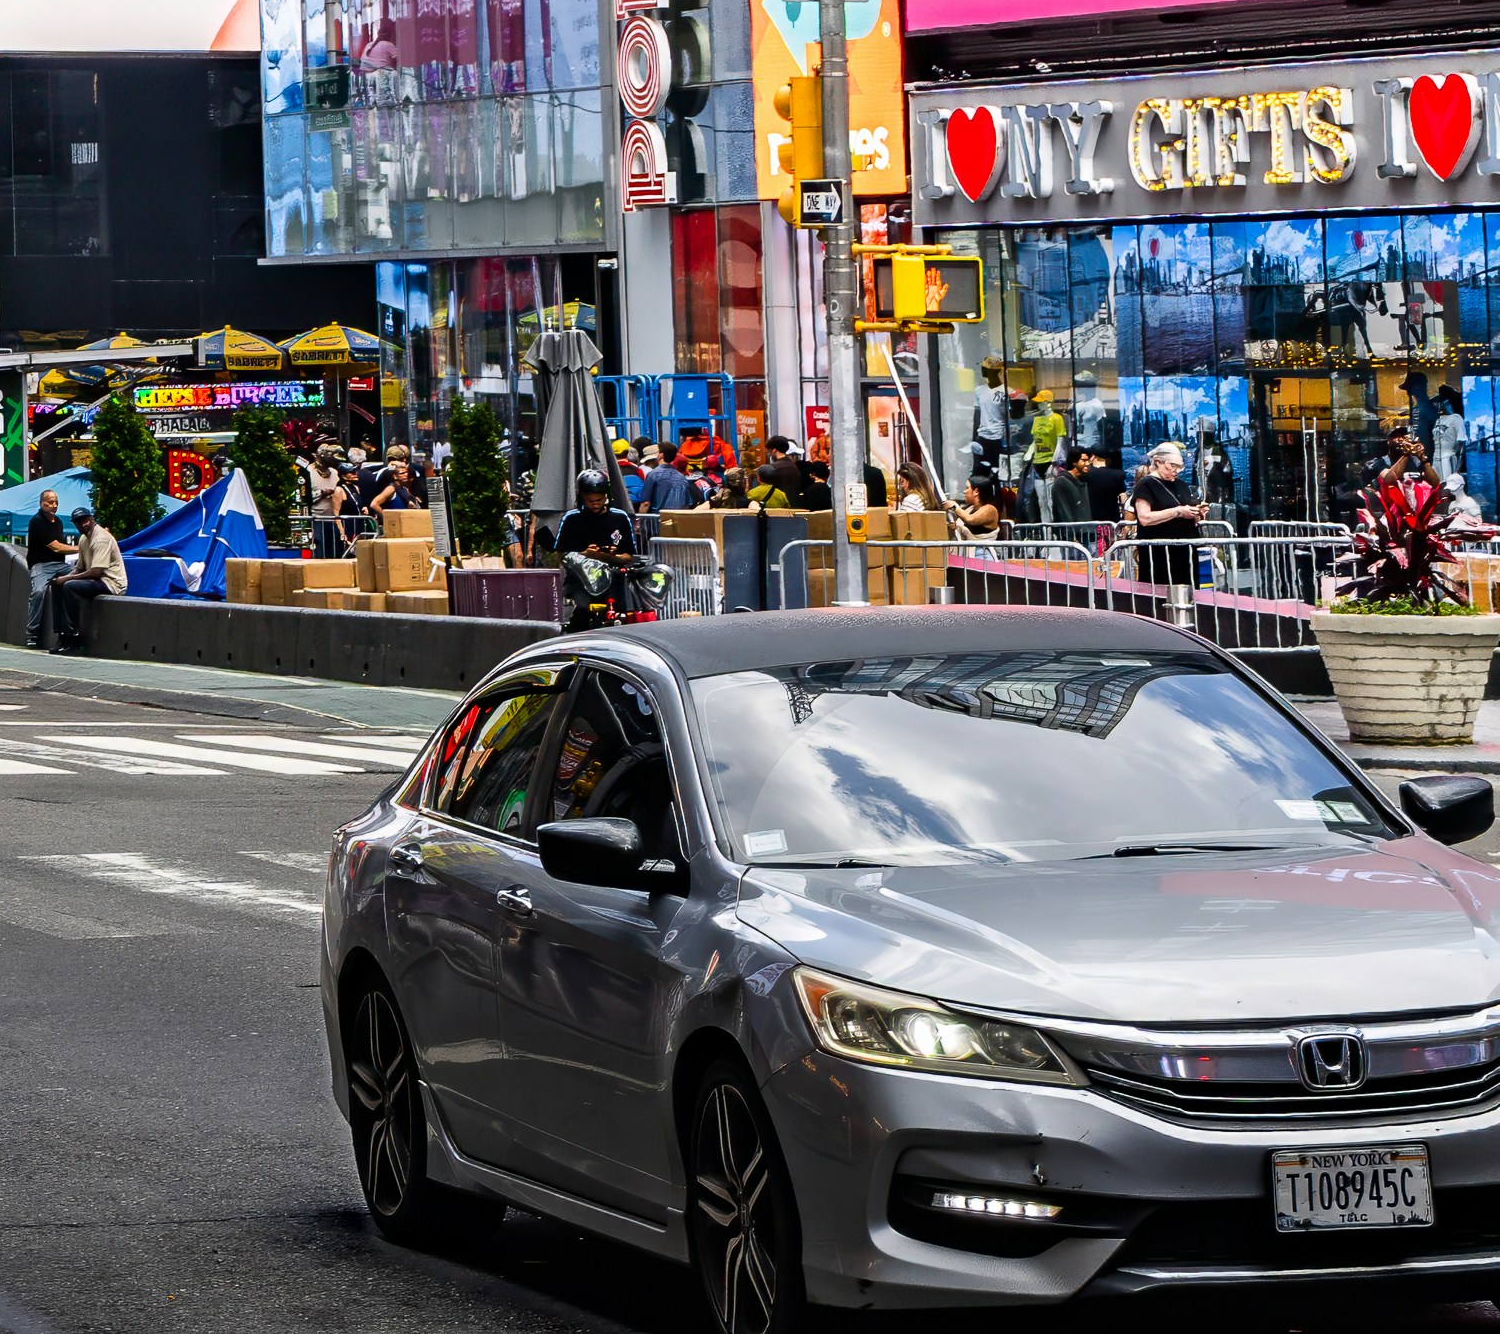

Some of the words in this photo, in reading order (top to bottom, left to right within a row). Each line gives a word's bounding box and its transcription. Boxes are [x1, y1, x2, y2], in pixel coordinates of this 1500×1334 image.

[1000, 101, 1124, 200] NY
[1127, 86, 1355, 192] GIFTS
[1311, 1154, 1343, 1167] NEW
[1346, 1152, 1390, 1166] YORK
[1286, 1168, 1417, 1212] T108945C
